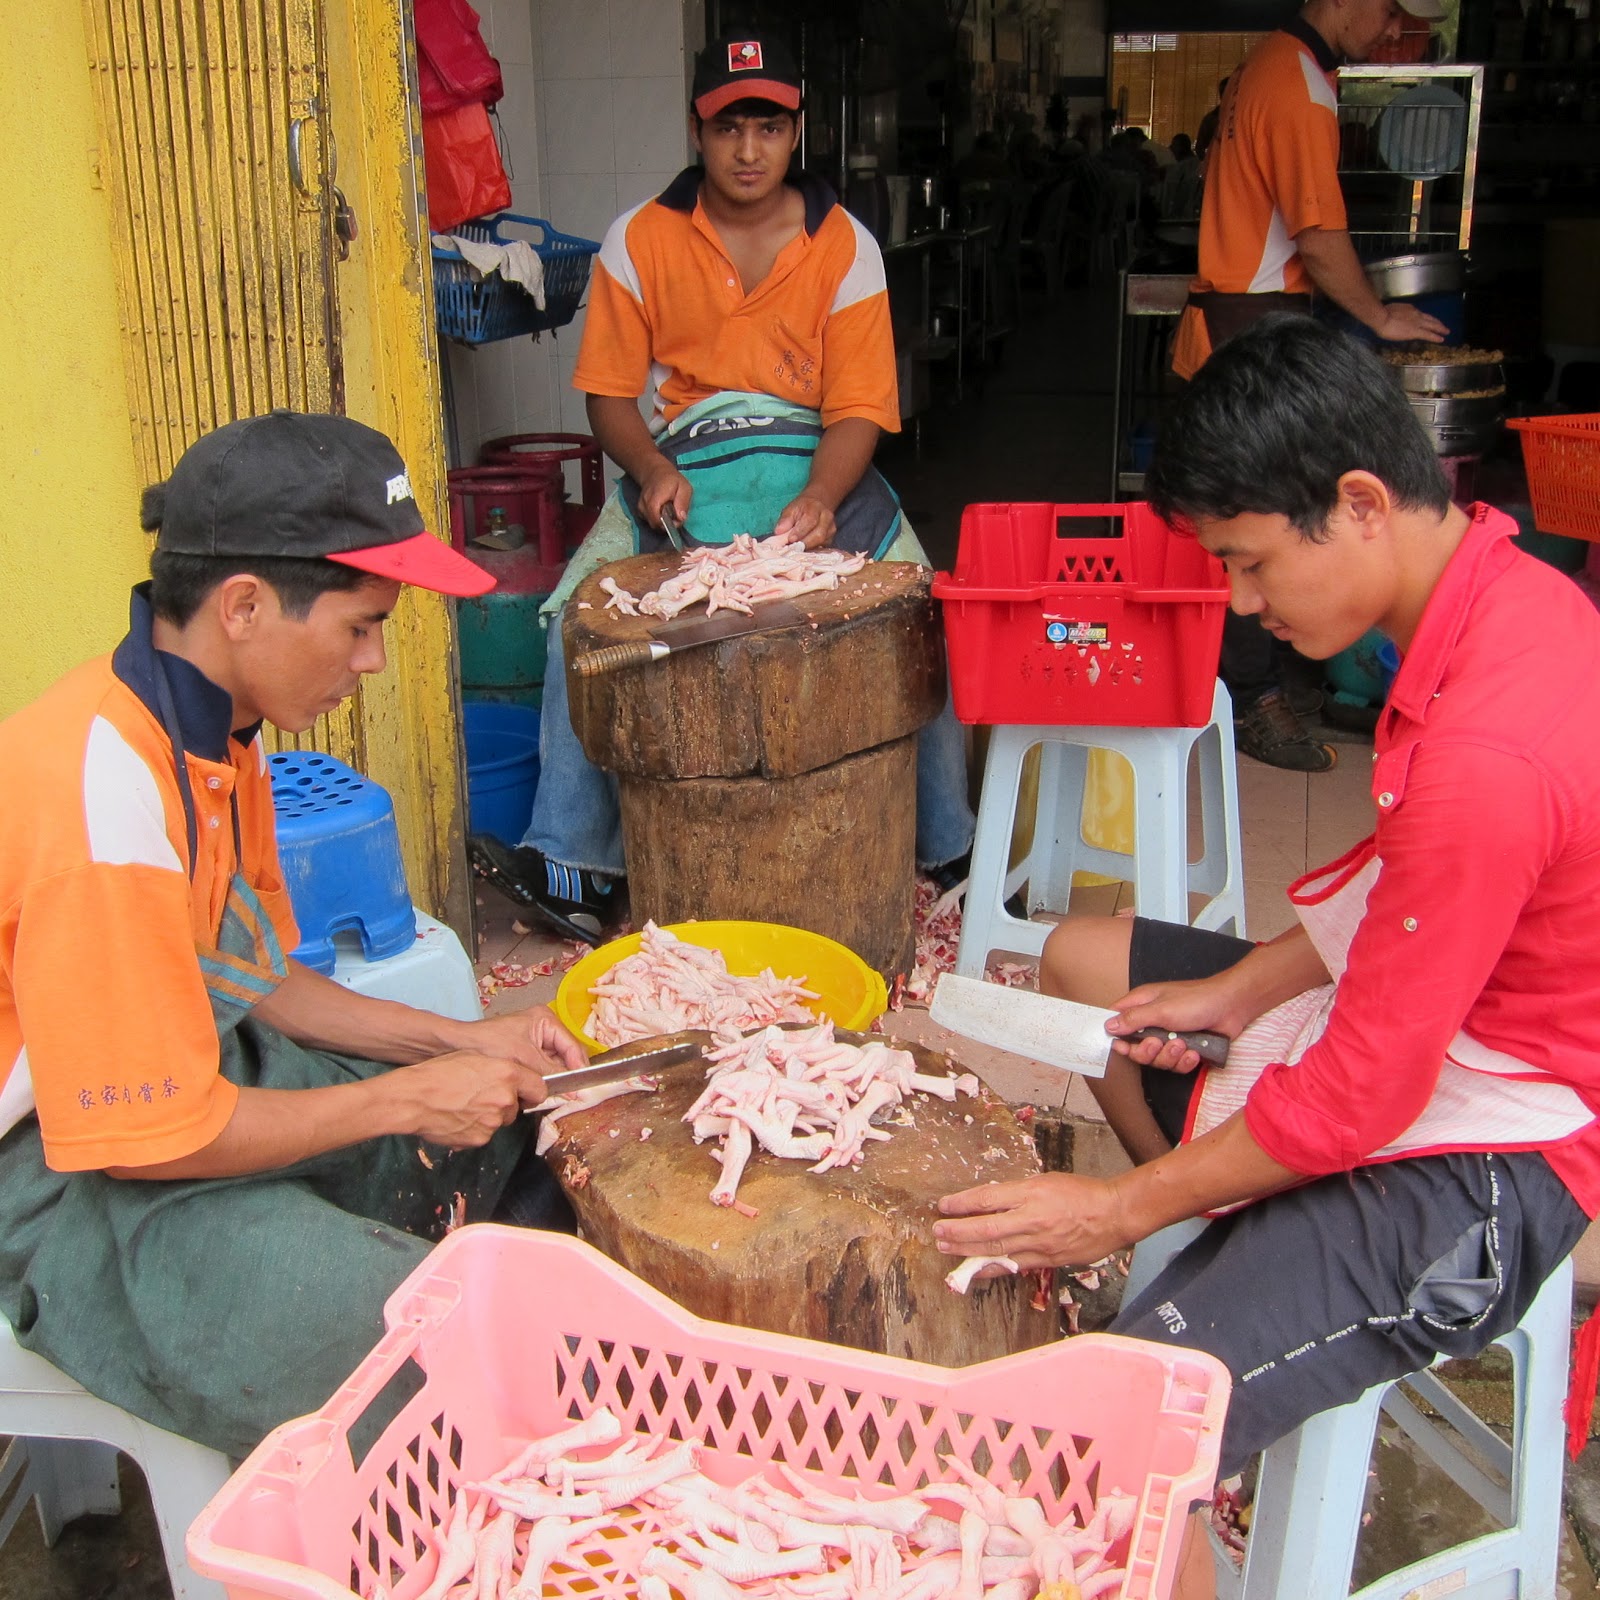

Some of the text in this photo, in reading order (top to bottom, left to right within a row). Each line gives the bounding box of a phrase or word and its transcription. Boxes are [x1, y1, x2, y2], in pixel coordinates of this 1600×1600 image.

[1242, 1361, 1276, 1382] SPORTS
[1284, 1341, 1317, 1361] SPORTS
[1325, 1323, 1359, 1343] SPORTS
